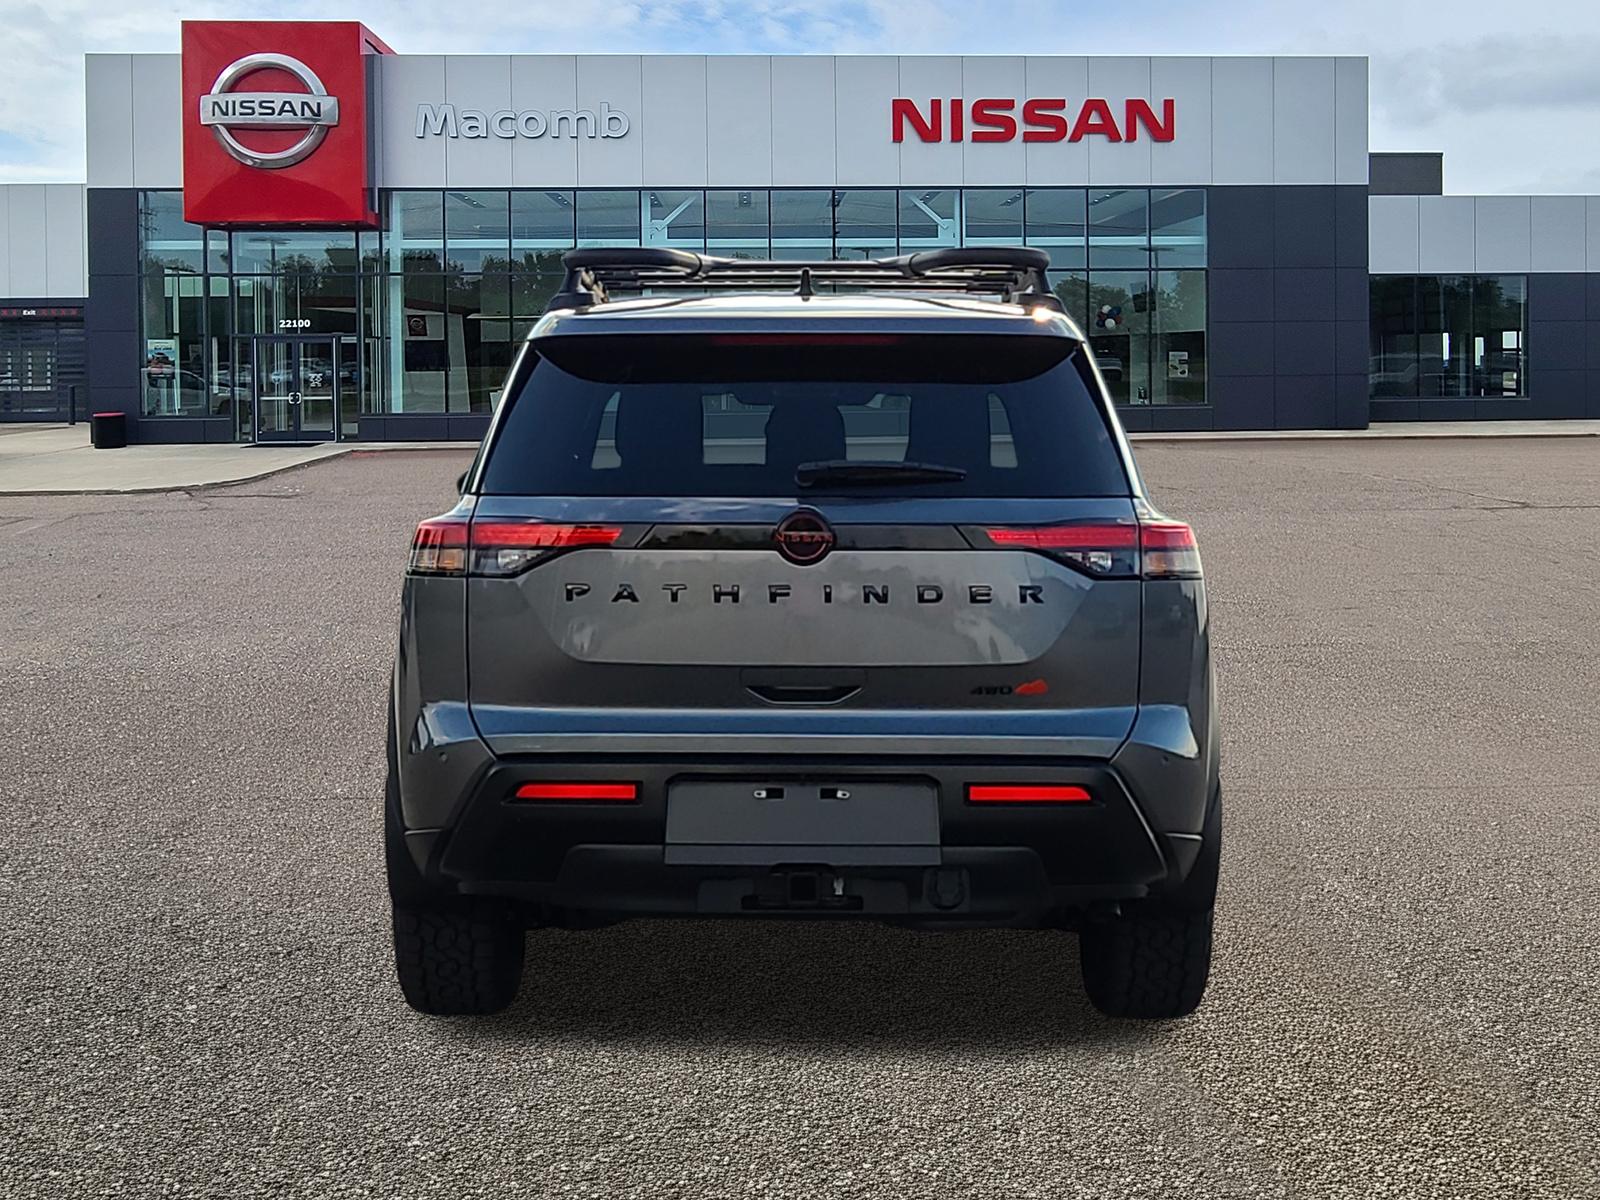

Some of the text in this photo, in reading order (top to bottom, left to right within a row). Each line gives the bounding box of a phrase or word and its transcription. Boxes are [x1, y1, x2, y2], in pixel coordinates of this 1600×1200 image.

[211, 100, 321, 117] NISSAN
[415, 102, 630, 138] Macomb
[892, 98, 1175, 142] NISSAN
[279, 319, 310, 328] 22100
[774, 531, 834, 543] NISSAN
[565, 584, 1046, 604] PATHFINDER
